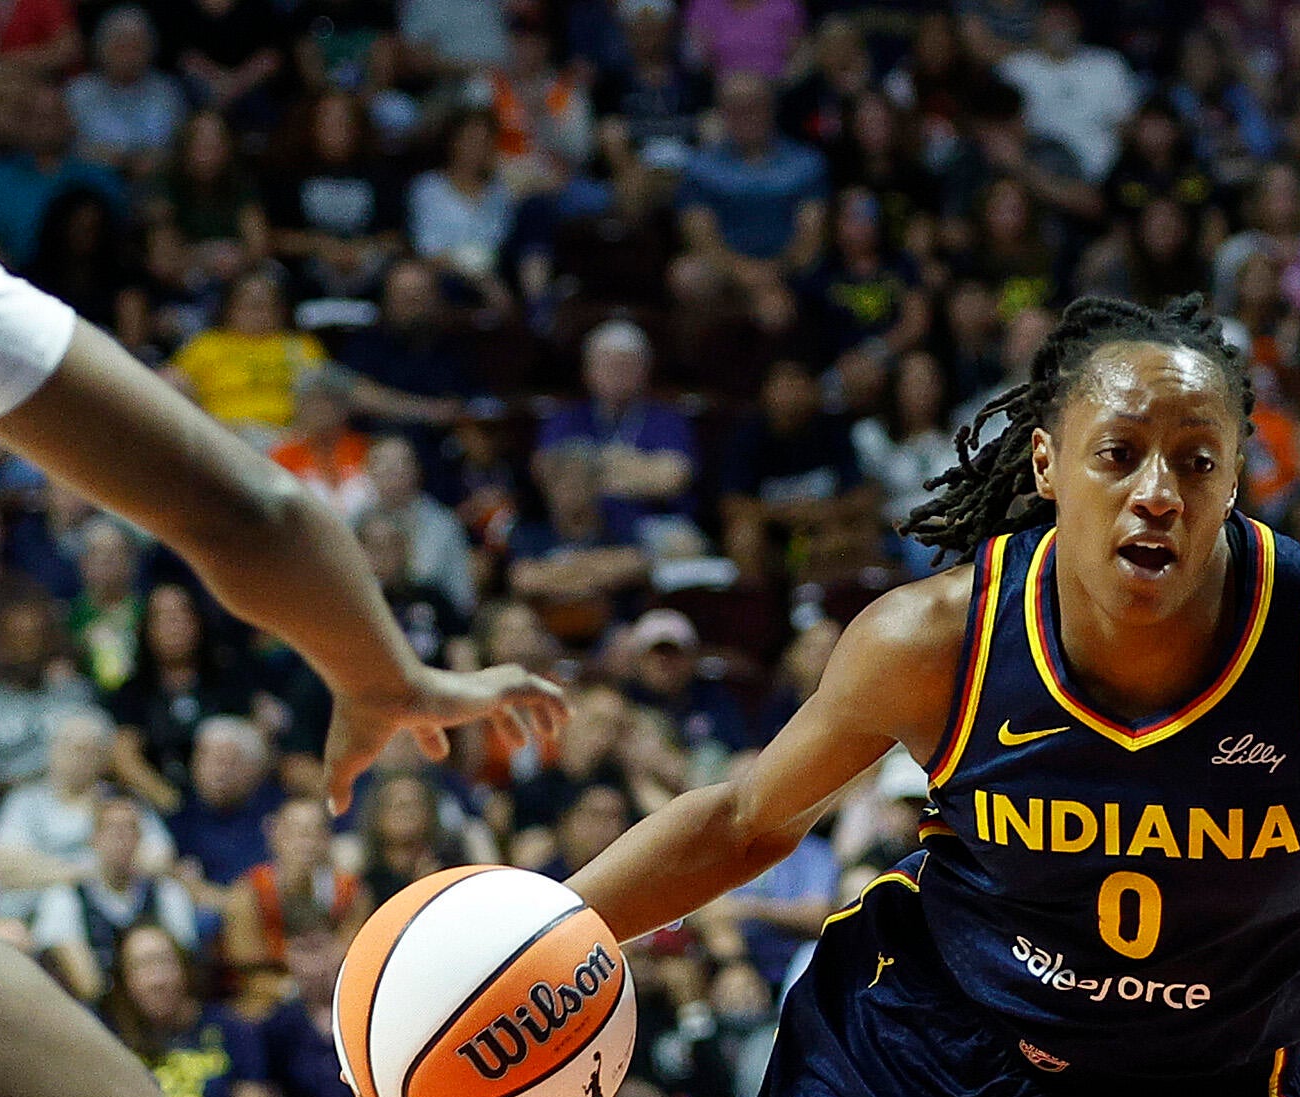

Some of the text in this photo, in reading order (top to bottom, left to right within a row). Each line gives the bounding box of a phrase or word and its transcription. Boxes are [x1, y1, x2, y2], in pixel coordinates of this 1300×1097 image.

[1211, 733, 1287, 774] Lilly
[974, 789, 1300, 859] INDIANA
[1098, 871, 1162, 959] 0
[456, 942, 617, 1080] Wilson
